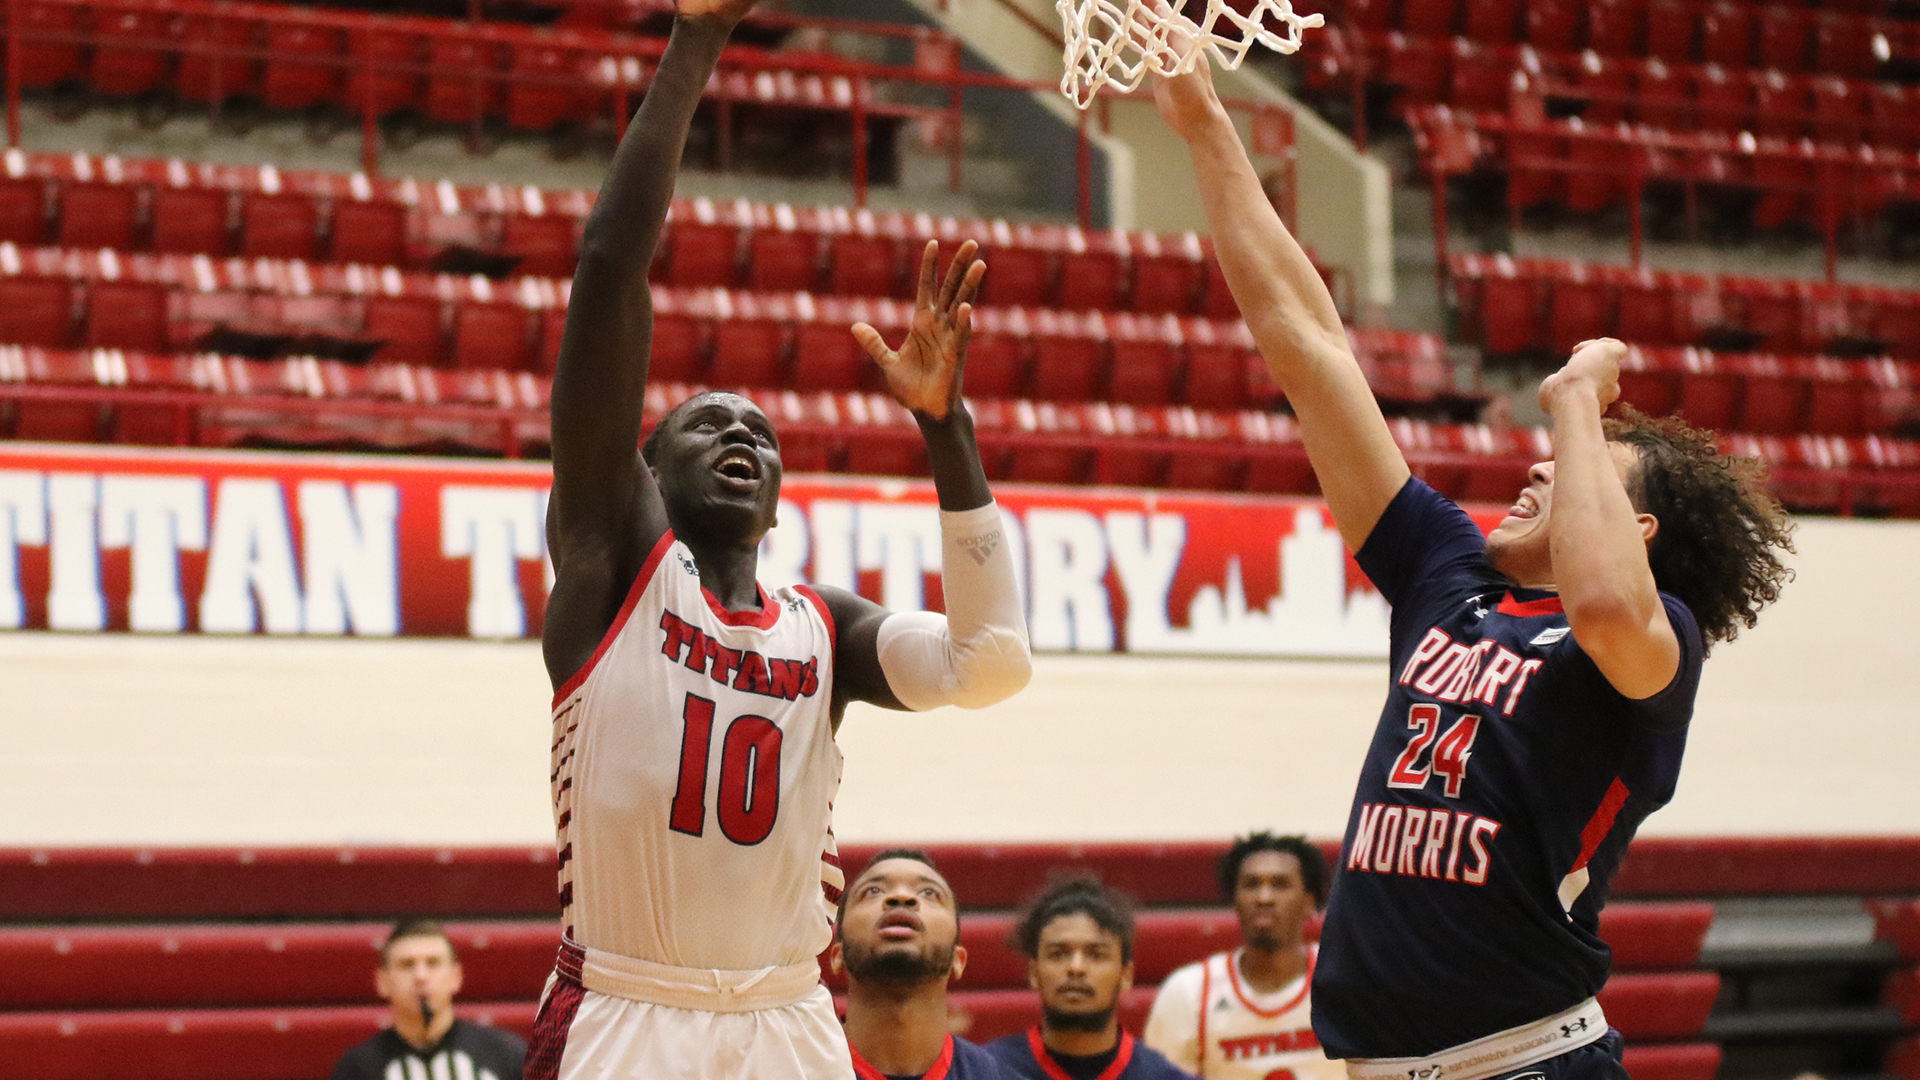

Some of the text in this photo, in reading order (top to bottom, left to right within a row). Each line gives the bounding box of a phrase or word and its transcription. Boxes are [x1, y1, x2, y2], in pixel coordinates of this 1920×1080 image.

[439, 484, 1188, 654] TITRY
[660, 608, 819, 702] TITANS
[1399, 626, 1546, 717] ROBERT
[669, 691, 783, 846] 10
[1386, 703, 1482, 799] 24
[1347, 803, 1502, 886] MORRIS
[1218, 1028, 1321, 1061] TITAN
[1513, 1032, 1558, 1054] UNDER
